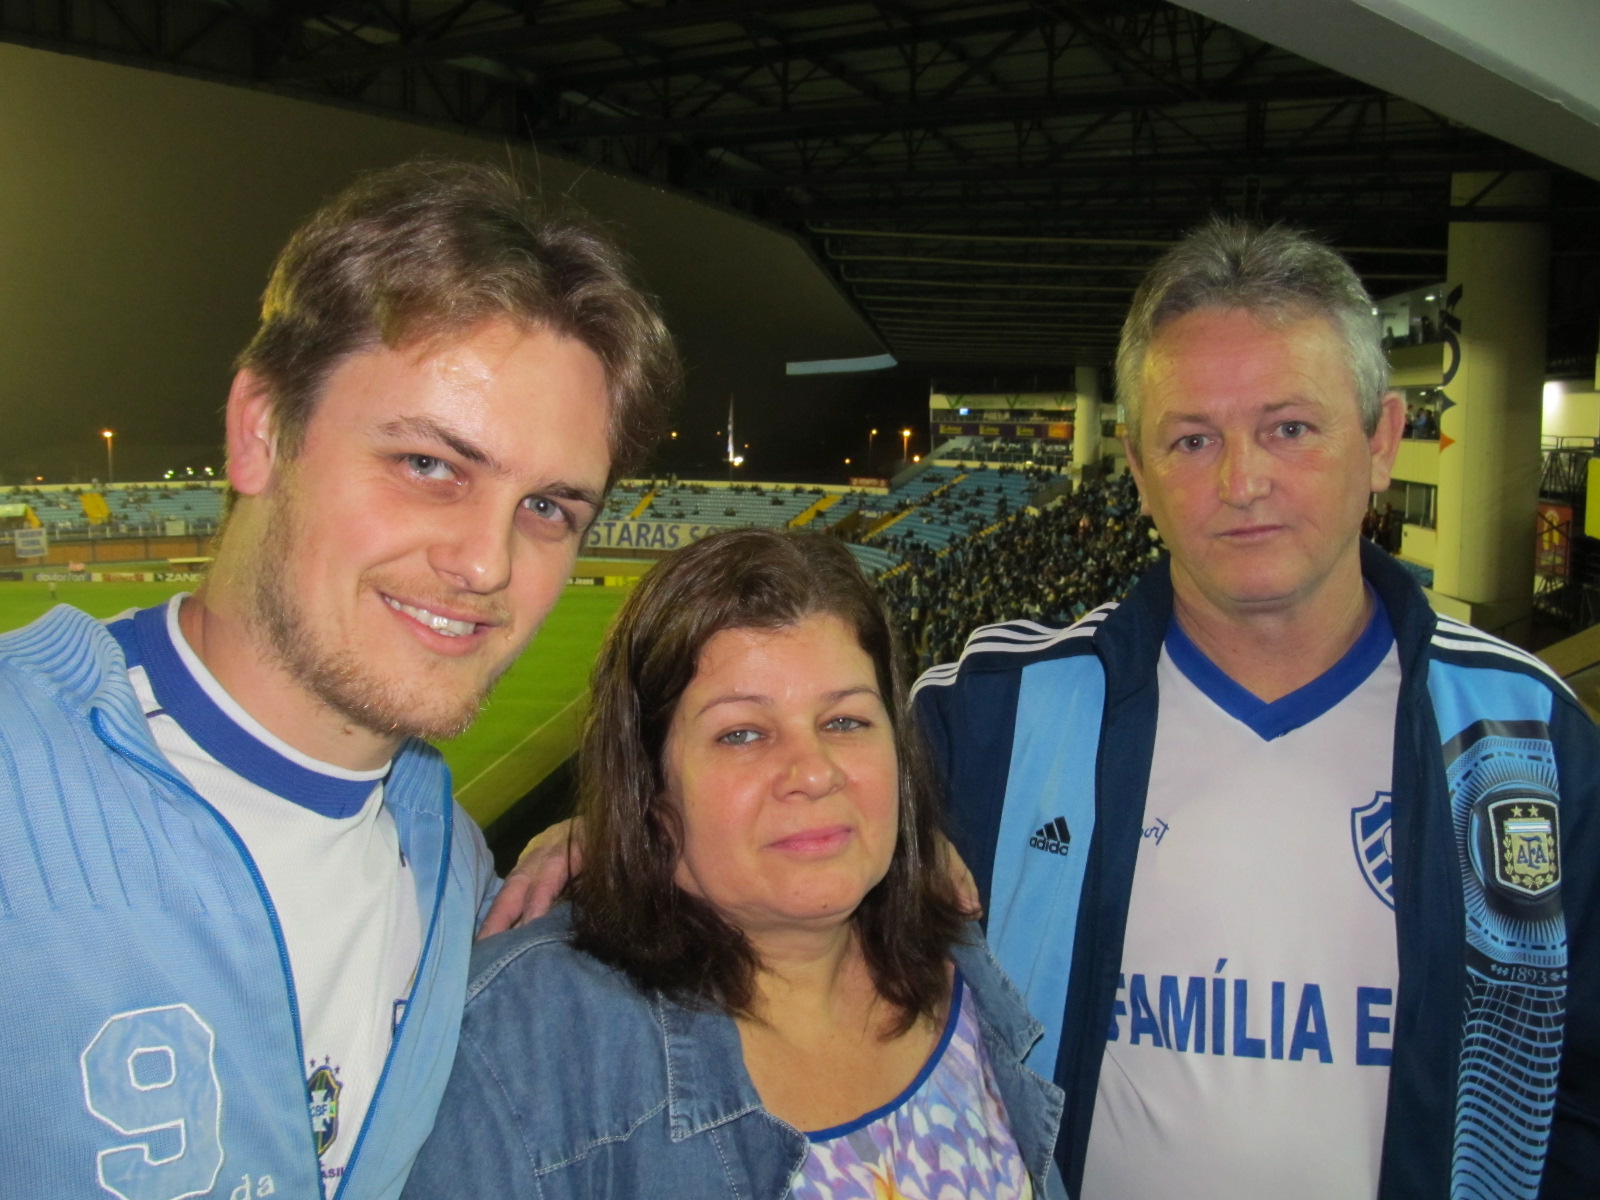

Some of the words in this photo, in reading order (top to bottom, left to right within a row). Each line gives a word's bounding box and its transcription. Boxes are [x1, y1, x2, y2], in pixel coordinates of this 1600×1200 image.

[1141, 817, 1169, 846] ort
[1517, 835, 1549, 870] AFA
[1510, 966, 1548, 985] 1893
[1106, 958, 1333, 1064] FAMÍLIA
[1356, 985, 1393, 1066] E
[80, 1002, 225, 1200] 9
